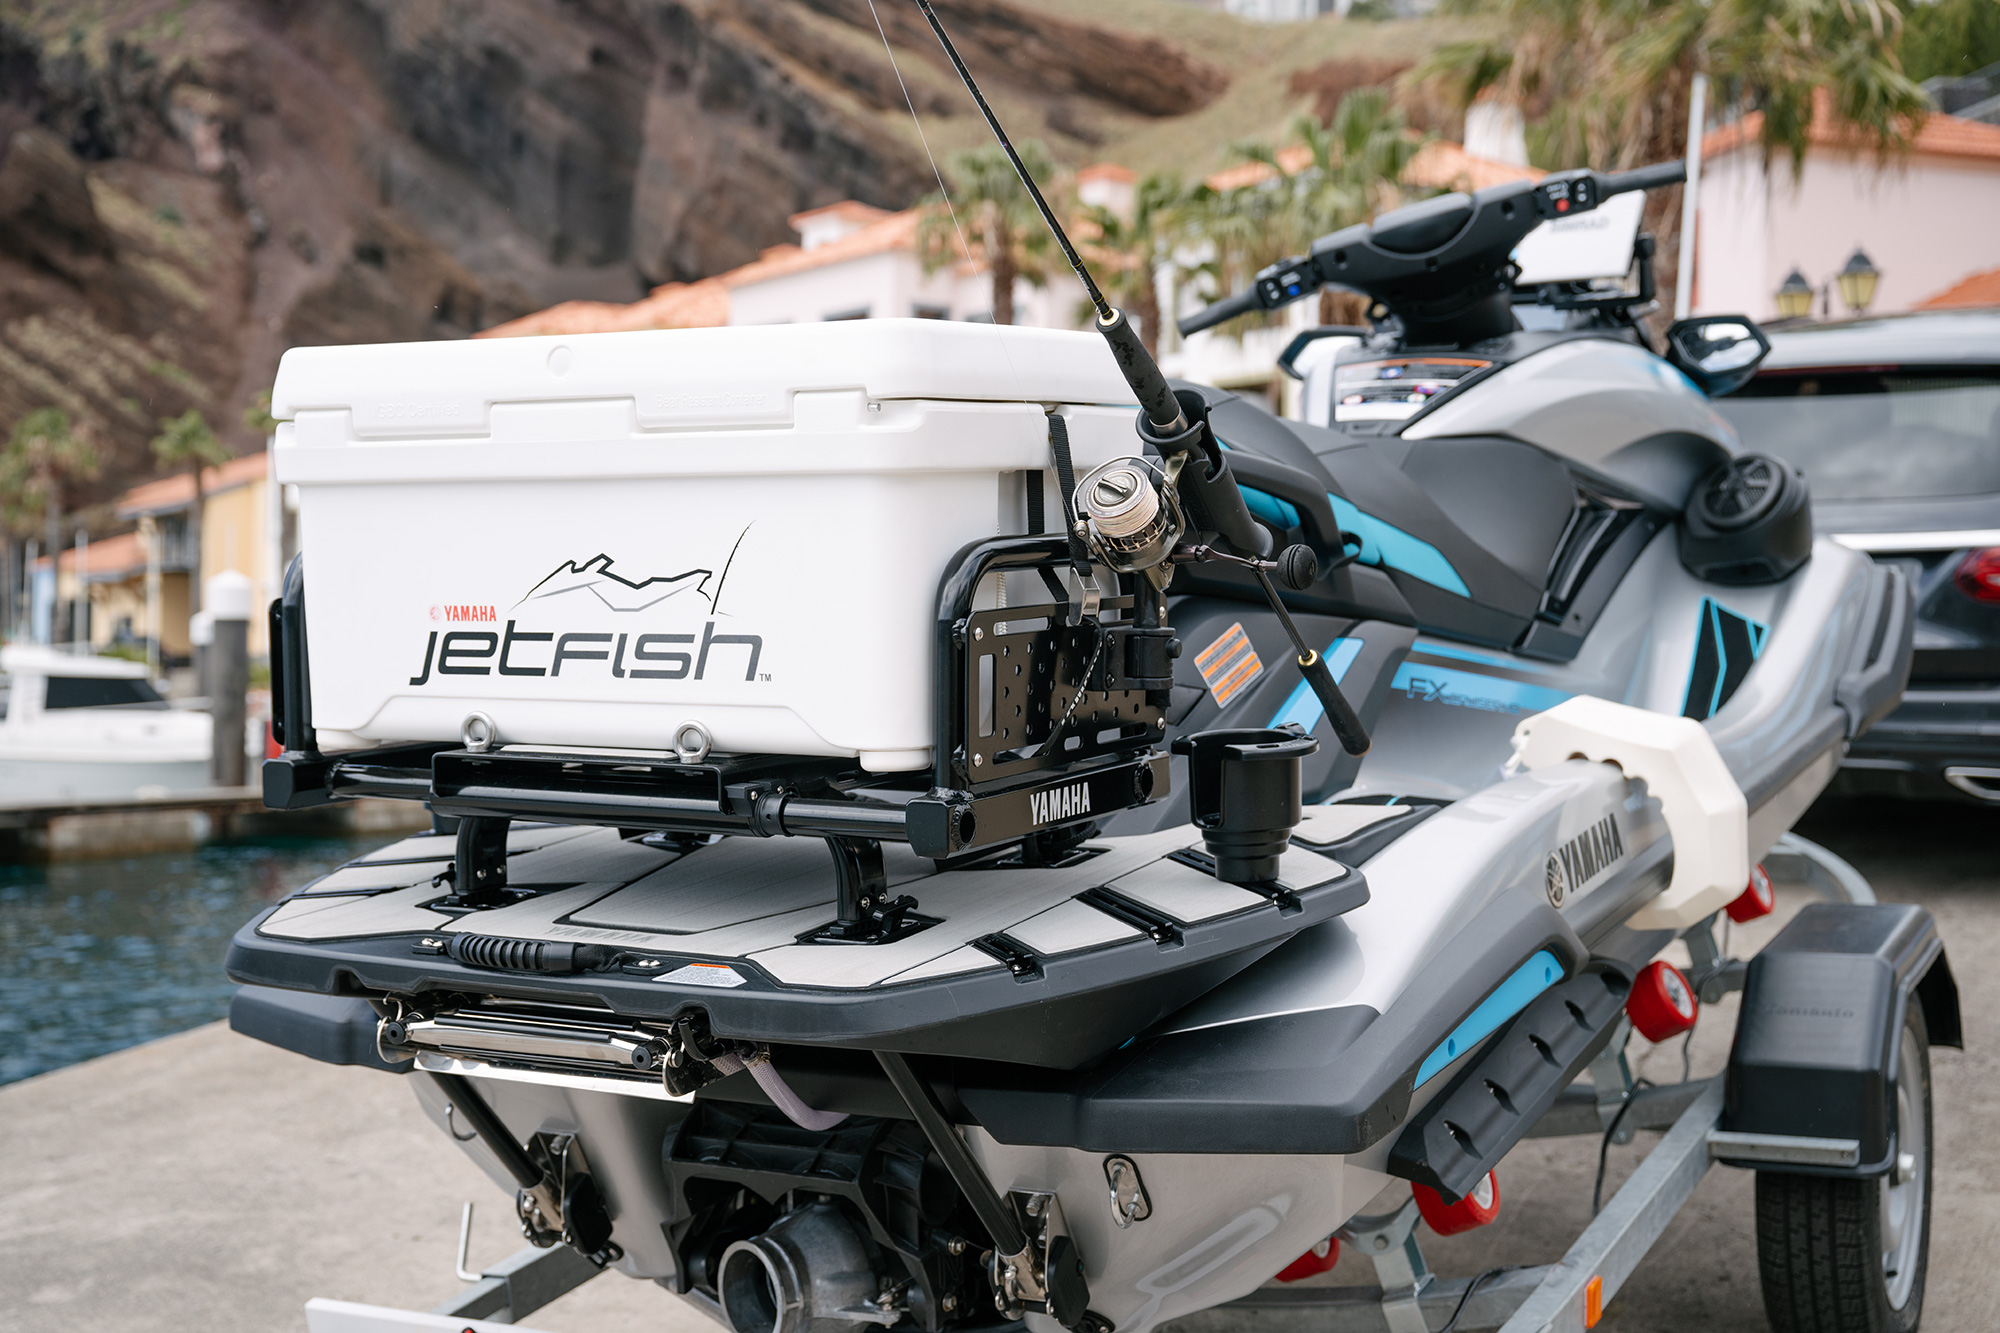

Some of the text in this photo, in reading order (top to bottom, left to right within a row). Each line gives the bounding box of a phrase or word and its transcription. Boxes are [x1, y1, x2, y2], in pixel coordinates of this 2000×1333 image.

[444, 605, 497, 622] YAMAHA
[1407, 677, 1448, 702] FX
[1030, 781, 1091, 826] YAMAHA
[1559, 813, 1624, 893] YAMAHA
